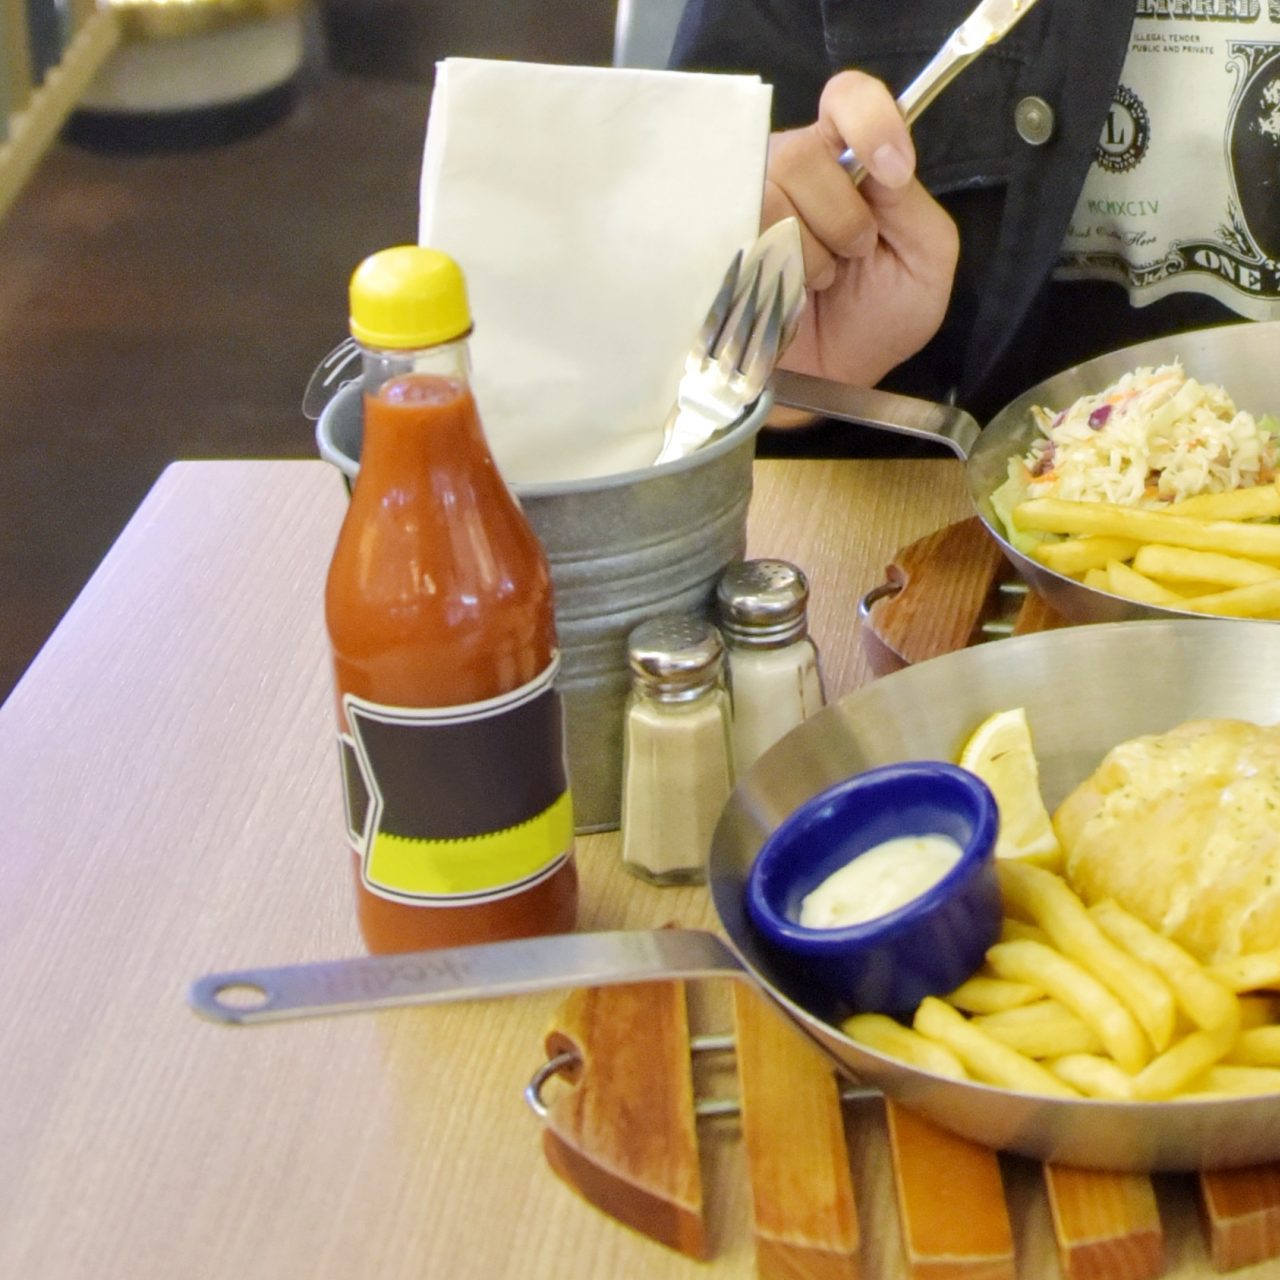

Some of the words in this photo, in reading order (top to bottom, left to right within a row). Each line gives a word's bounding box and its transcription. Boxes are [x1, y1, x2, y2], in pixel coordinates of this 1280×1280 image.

[1168, 33, 1201, 43] TENDER
[1131, 44, 1161, 53] PUBLIC
[1163, 45, 1180, 53] AND
[1182, 45, 1215, 55] PRIVATE
[1087, 200, 1160, 217] MCMXCIV
[1194, 249, 1262, 291] ONE
